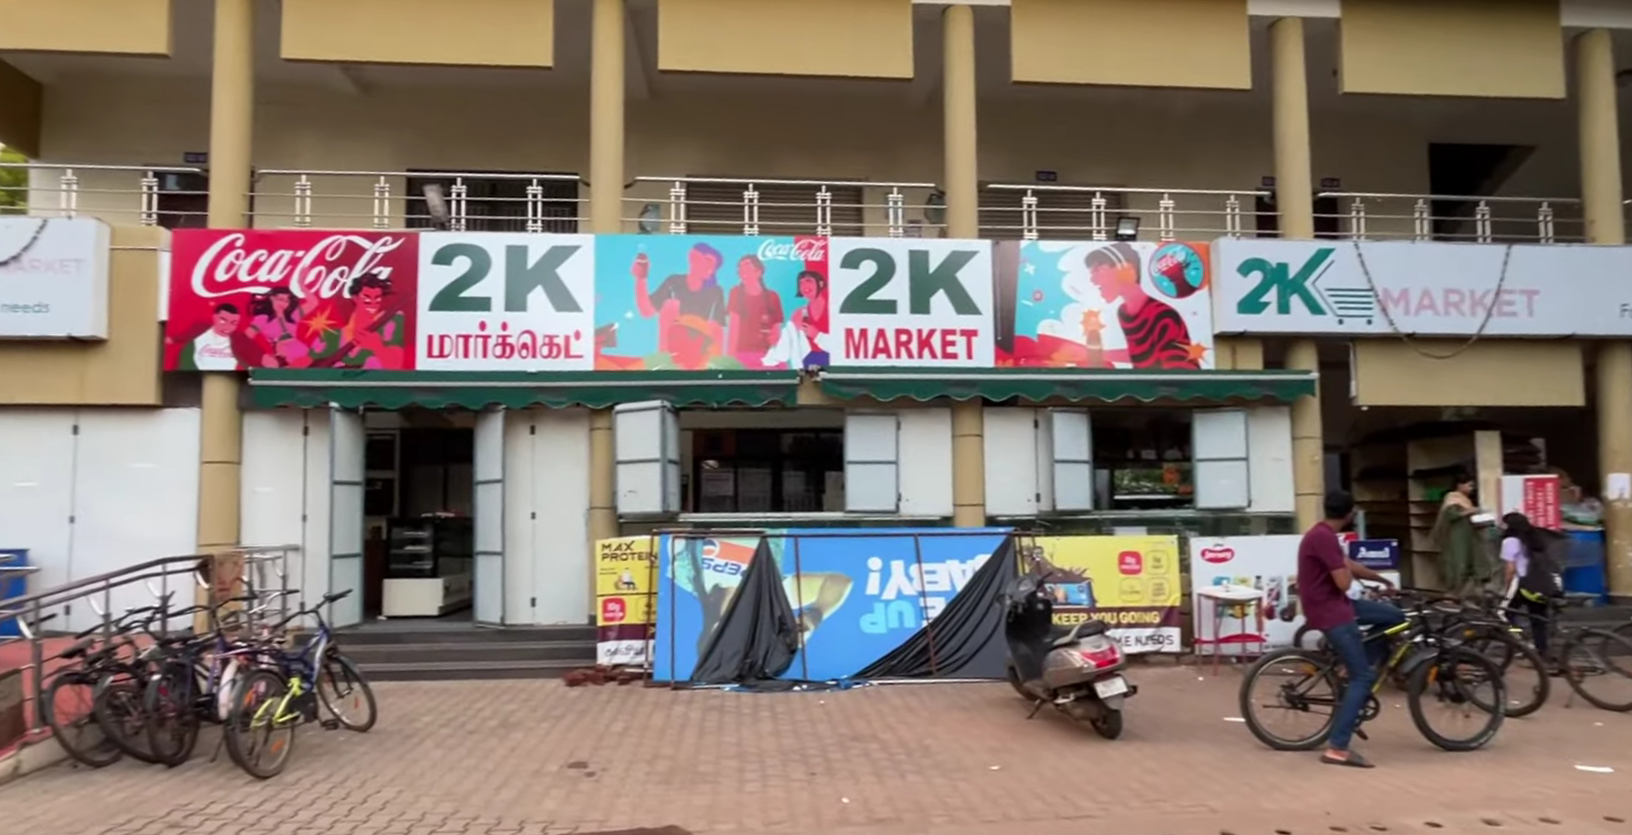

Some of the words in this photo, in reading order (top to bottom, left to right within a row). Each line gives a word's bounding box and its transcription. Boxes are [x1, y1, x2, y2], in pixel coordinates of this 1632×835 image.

[757, 239, 827, 261] Coca-Cola
[428, 243, 584, 313] 2K
[838, 247, 983, 316] 2K
[1236, 248, 1336, 316] 2K
[1381, 287, 1541, 318] MARKET
[426, 321, 584, 359] மார்க்கெட்
[844, 327, 979, 361] MARKET
[601, 540, 635, 552] MAX
[864, 553, 993, 600] ABY!
[859, 600, 916, 634] UP
[1051, 612, 1088, 626] KEEP
[1119, 611, 1161, 624] GOING
